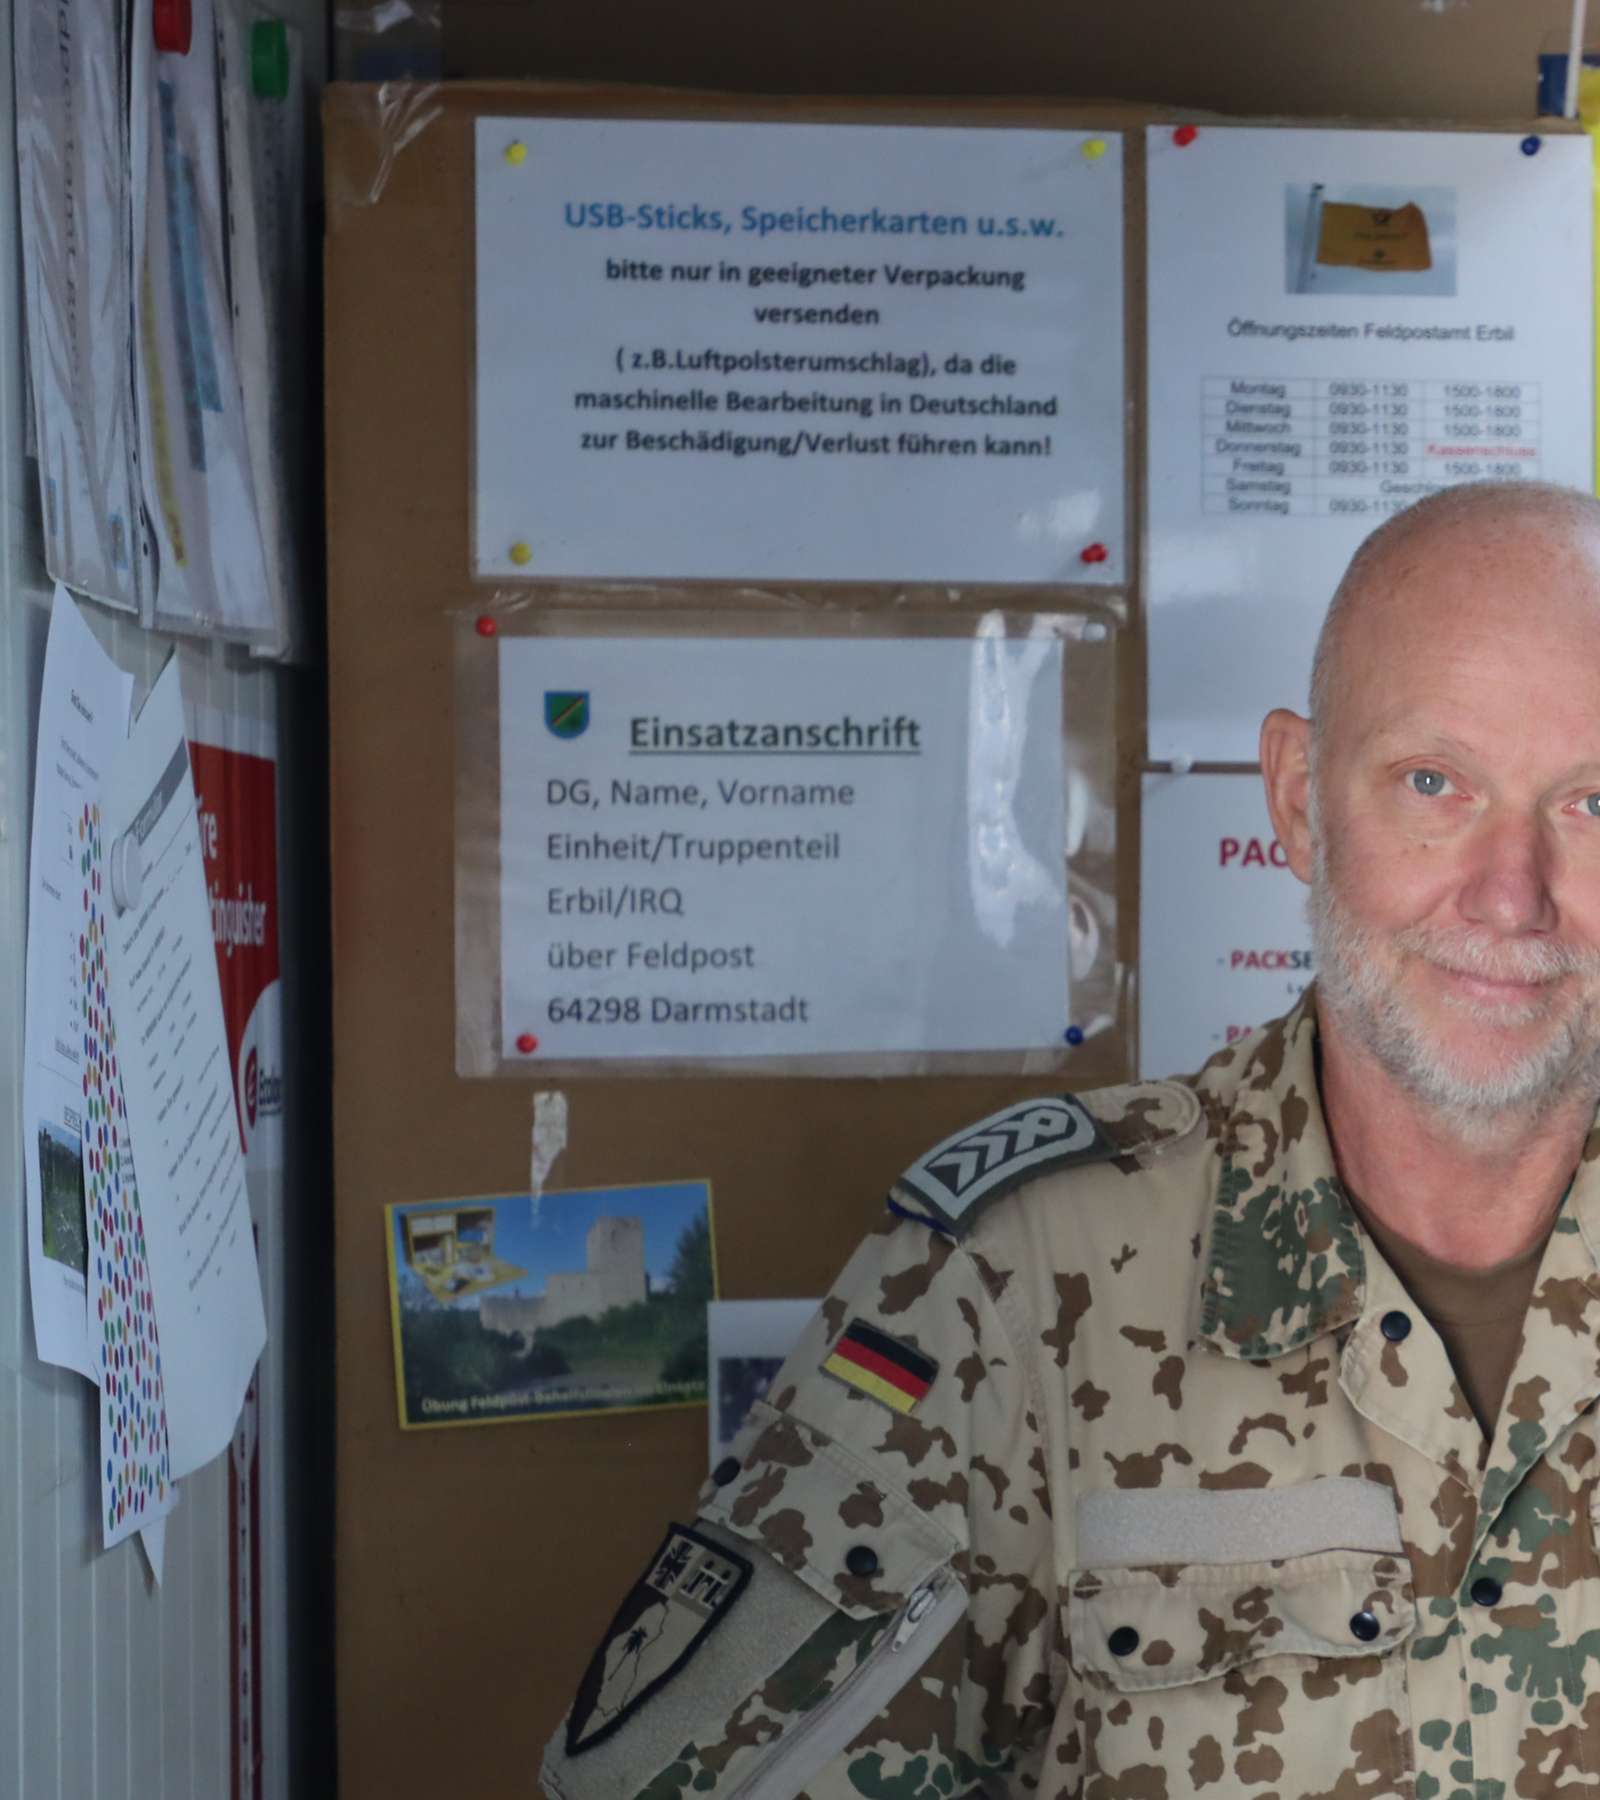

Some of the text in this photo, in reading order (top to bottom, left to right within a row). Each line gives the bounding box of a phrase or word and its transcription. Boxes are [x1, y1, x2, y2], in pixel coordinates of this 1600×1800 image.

[565, 203, 1064, 237] USB-Sticks, Speicherkarten u.s.w.
[606, 258, 1025, 292] bitte nur in geeigneter Verpackung
[754, 304, 880, 325] versenden
[1227, 317, 1515, 342] Öffnungszeiten Feldpostamt Erbil
[632, 348, 936, 378] z.B.Luftpolsterumschlag),
[943, 353, 973, 375] da
[979, 354, 1016, 376] die
[574, 388, 1058, 418] maschinelle Bearbeitung in Deutschland
[1230, 381, 1286, 399] Montag
[1226, 402, 1291, 418] Dienstag
[1226, 420, 1291, 434] Mittwoch
[581, 429, 1051, 458] zur Beschädigung/Verlust führen kann!
[1216, 440, 1301, 457] Donnerstag
[1232, 460, 1284, 477] Freitag
[1226, 479, 1291, 496] Samstag
[1228, 499, 1289, 515] Sonntag
[630, 716, 922, 749] Einsatzanschrift
[547, 779, 854, 810] DG, Name, Vorname
[548, 831, 839, 865] Einheit/Truppenteil
[548, 885, 684, 919] Erbil/IRQ
[548, 941, 754, 974] über Feldpost
[548, 996, 808, 1024] 64298 Darmstadt
